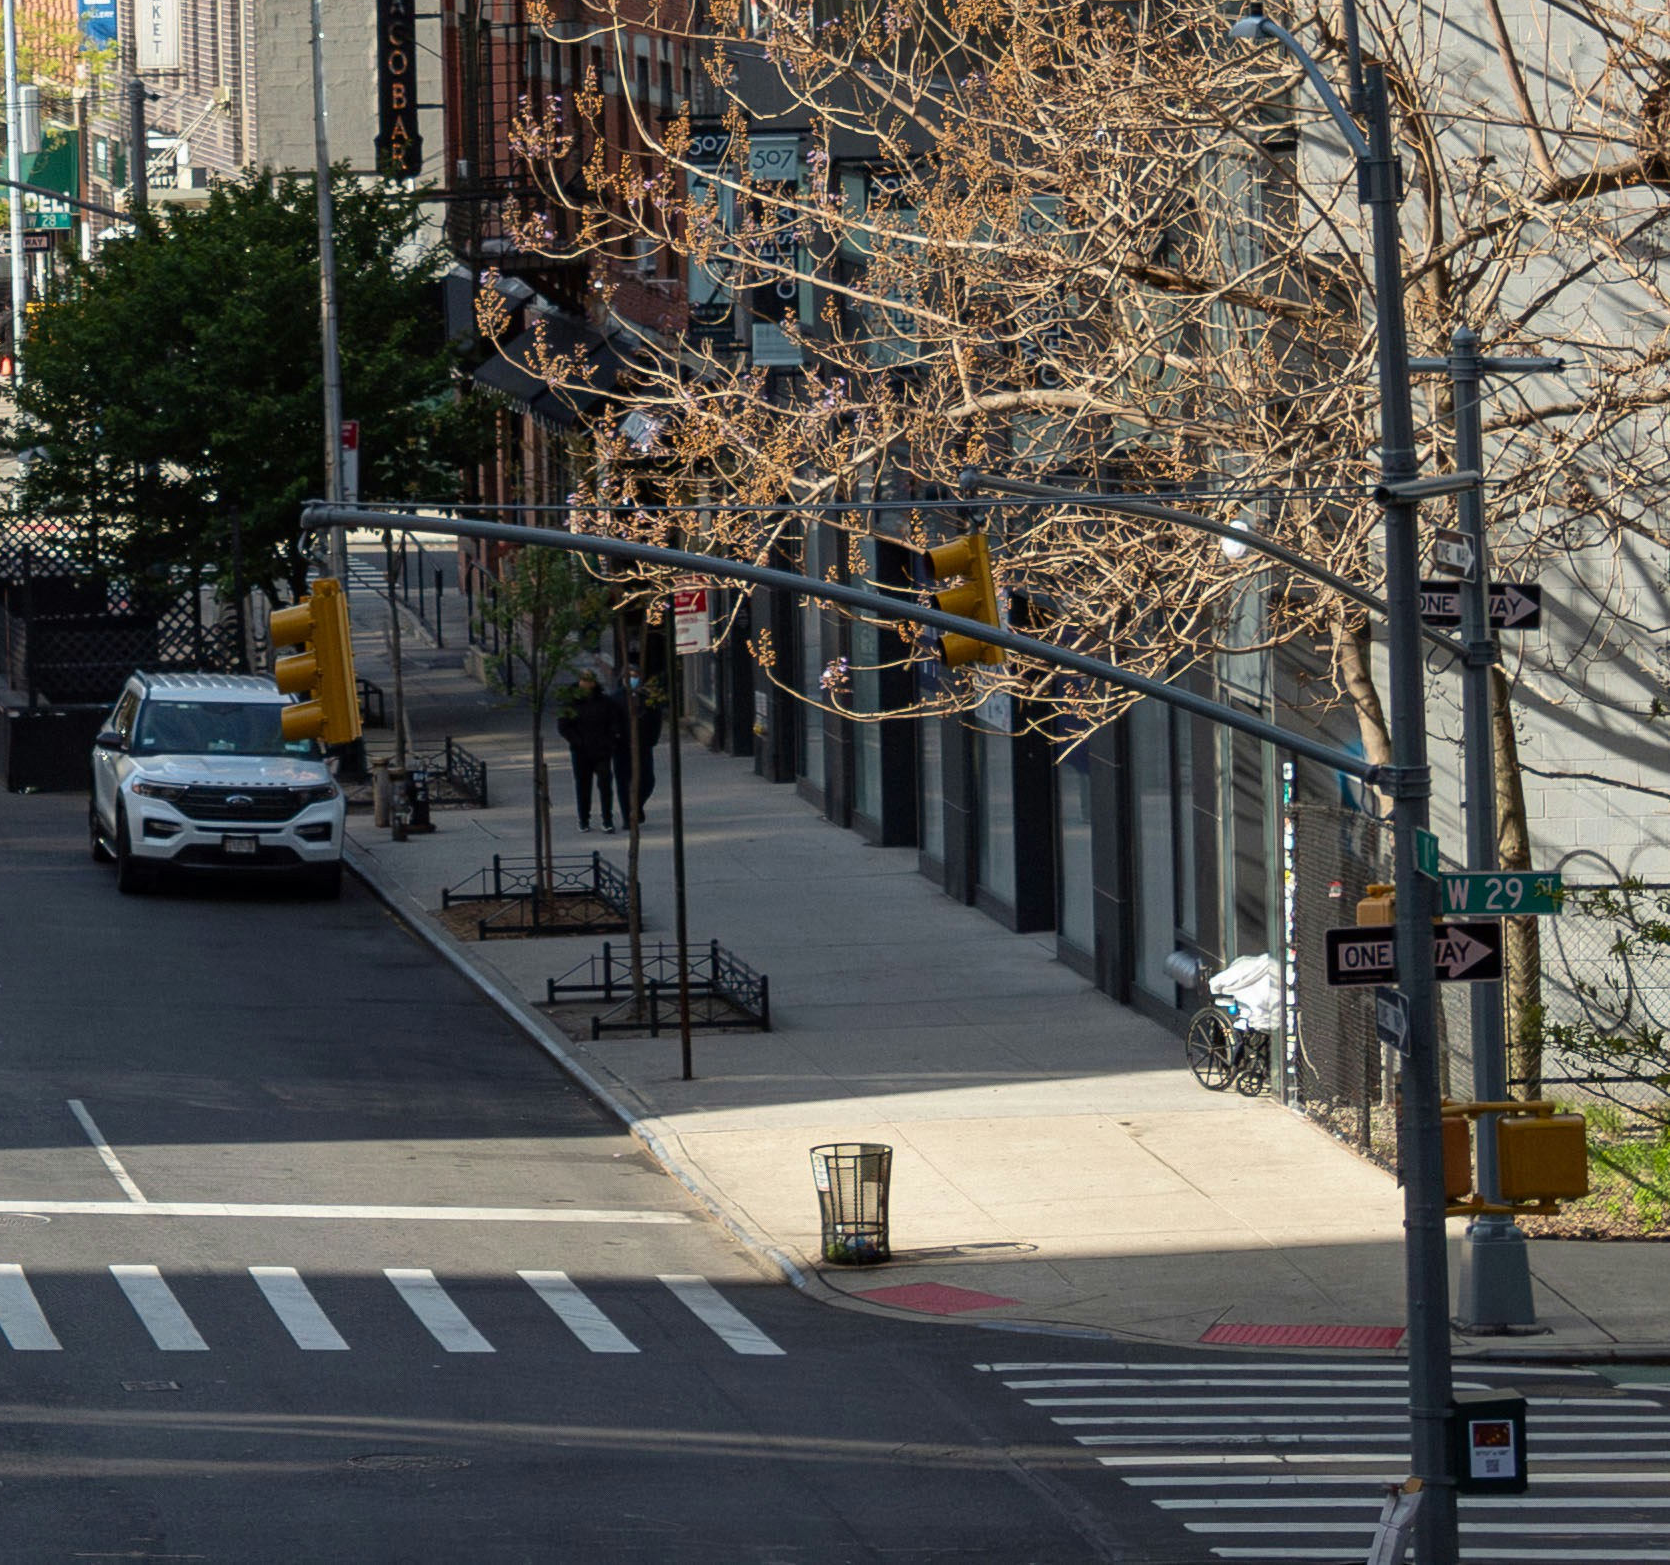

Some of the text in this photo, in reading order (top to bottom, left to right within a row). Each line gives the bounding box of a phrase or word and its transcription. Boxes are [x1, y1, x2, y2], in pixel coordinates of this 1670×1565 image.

[689, 135, 729, 155] 507
[752, 149, 794, 170] 507
[41, 214, 56, 227] 28
[1446, 879, 1470, 911] W
[1484, 877, 1523, 910] 29
[1344, 942, 1471, 969] ONE AY
